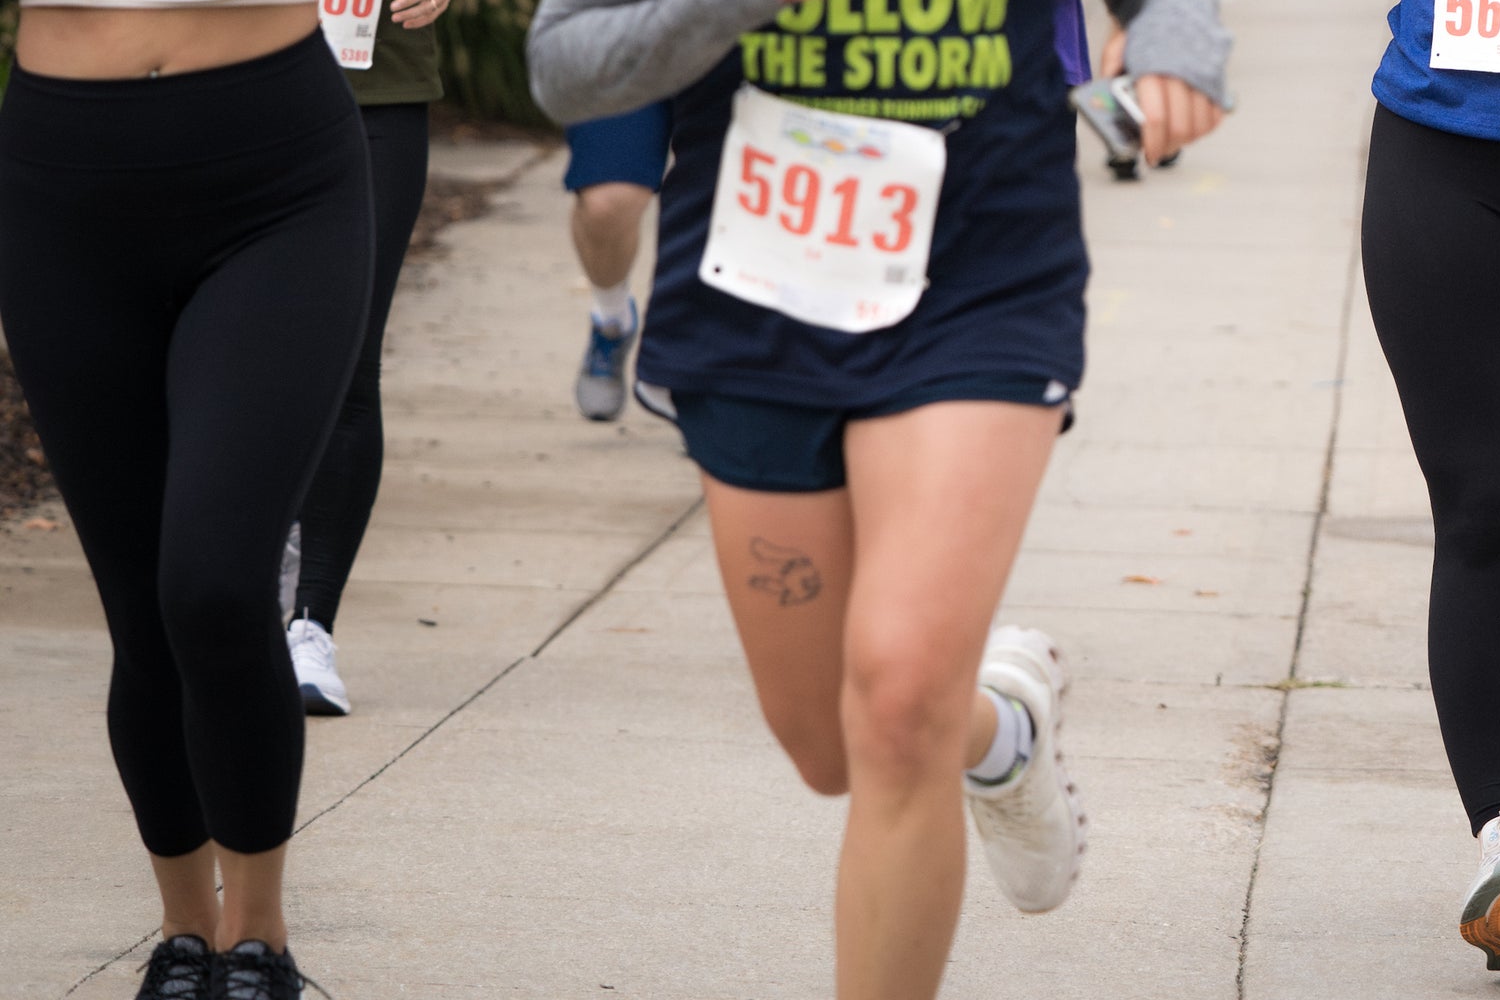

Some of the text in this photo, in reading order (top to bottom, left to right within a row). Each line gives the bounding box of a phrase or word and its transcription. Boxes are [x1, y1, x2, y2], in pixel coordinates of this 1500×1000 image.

[739, 32, 1013, 90] THE STORM
[736, 143, 920, 255] 5913
